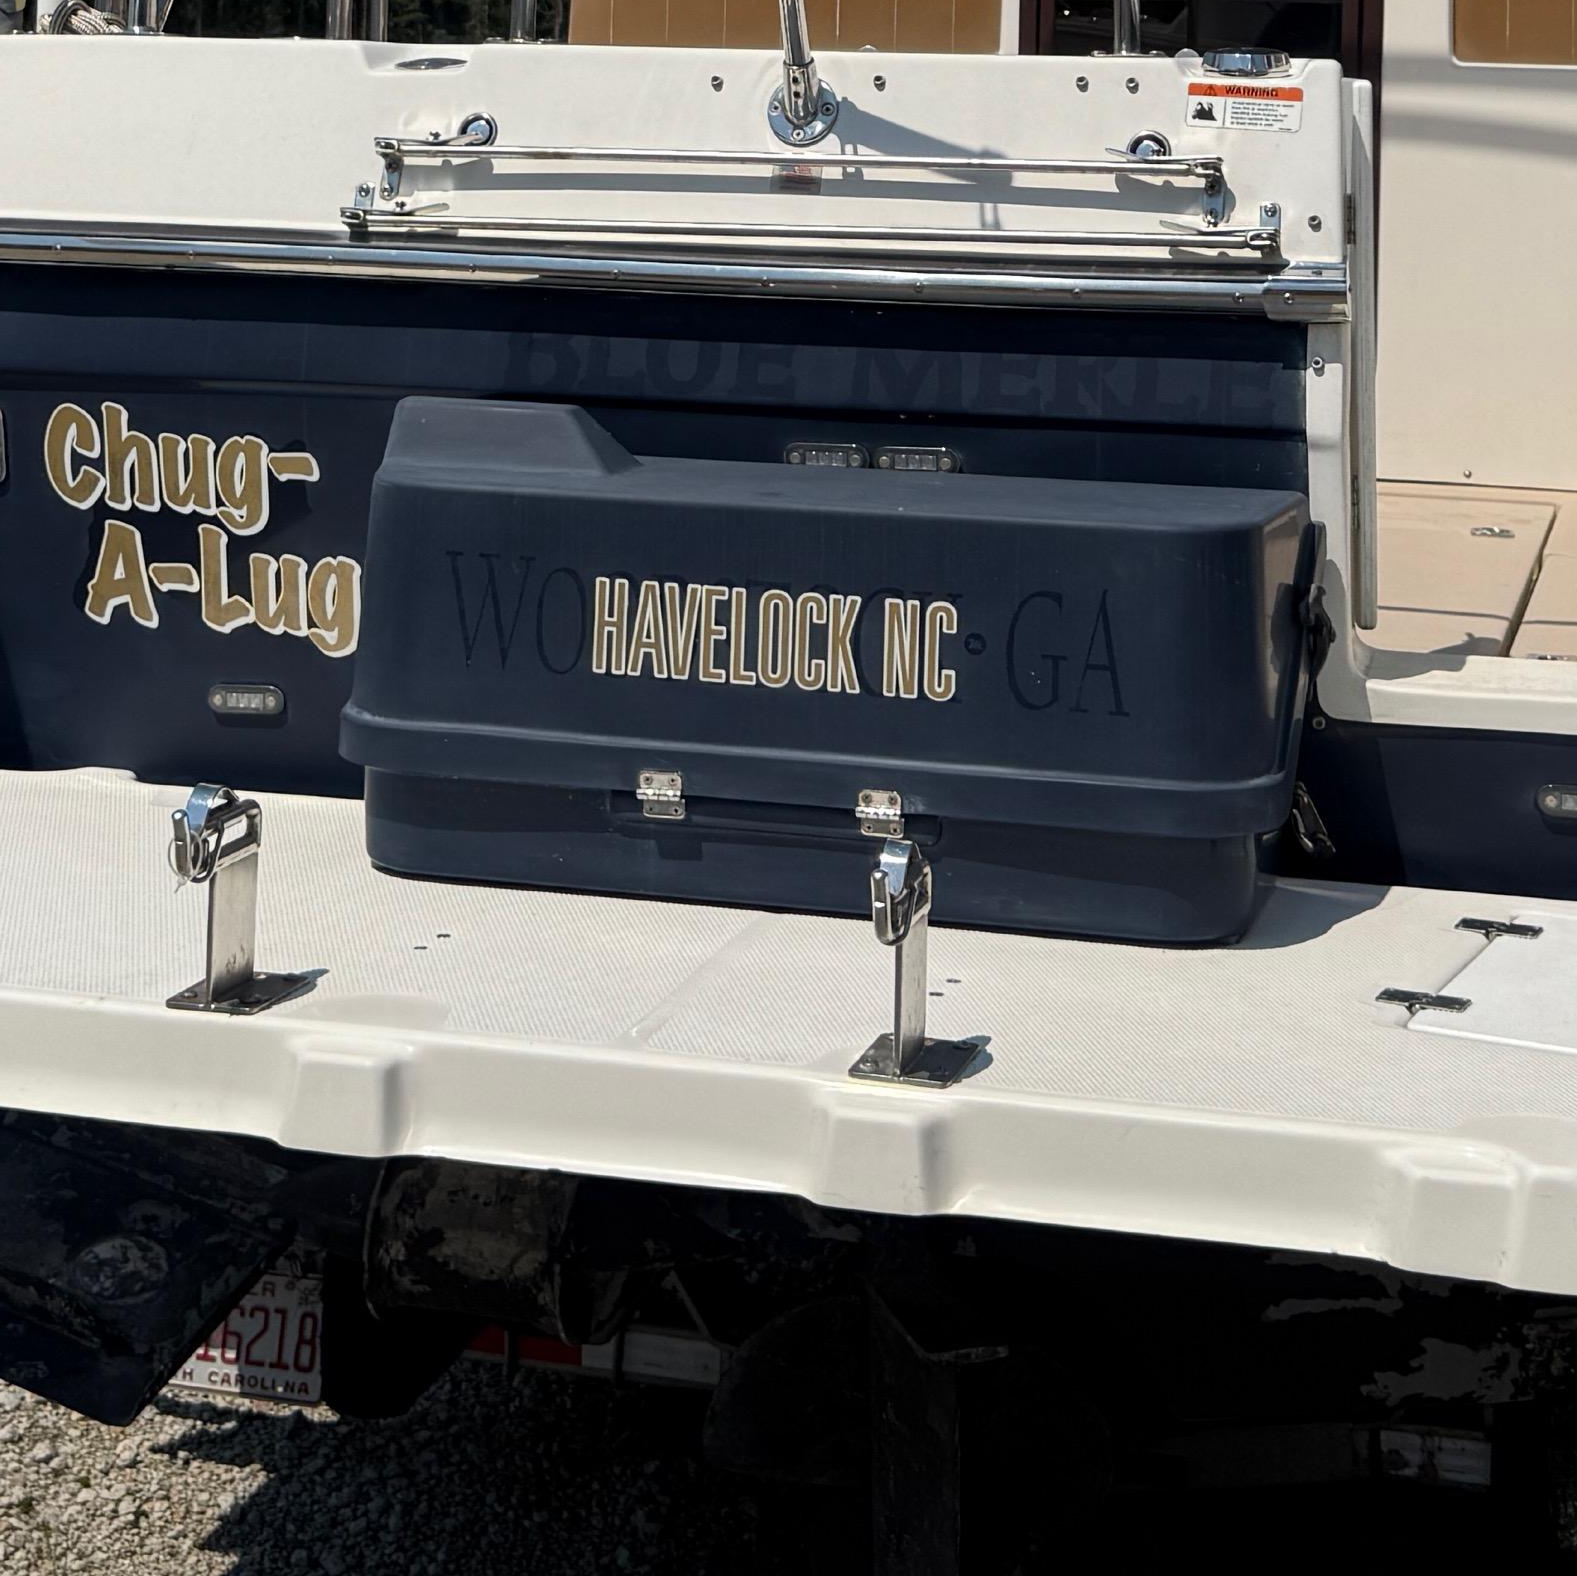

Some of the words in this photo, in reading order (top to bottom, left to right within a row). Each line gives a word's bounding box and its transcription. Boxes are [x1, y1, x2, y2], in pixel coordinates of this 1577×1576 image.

[1224, 85, 1280, 98] WARNING
[44, 401, 321, 536] Chug-
[84, 519, 362, 658] A-Lug
[591, 576, 861, 695] HAVELOCK
[882, 597, 959, 702] NC
[207, 1369, 311, 1396] CAROLINA
